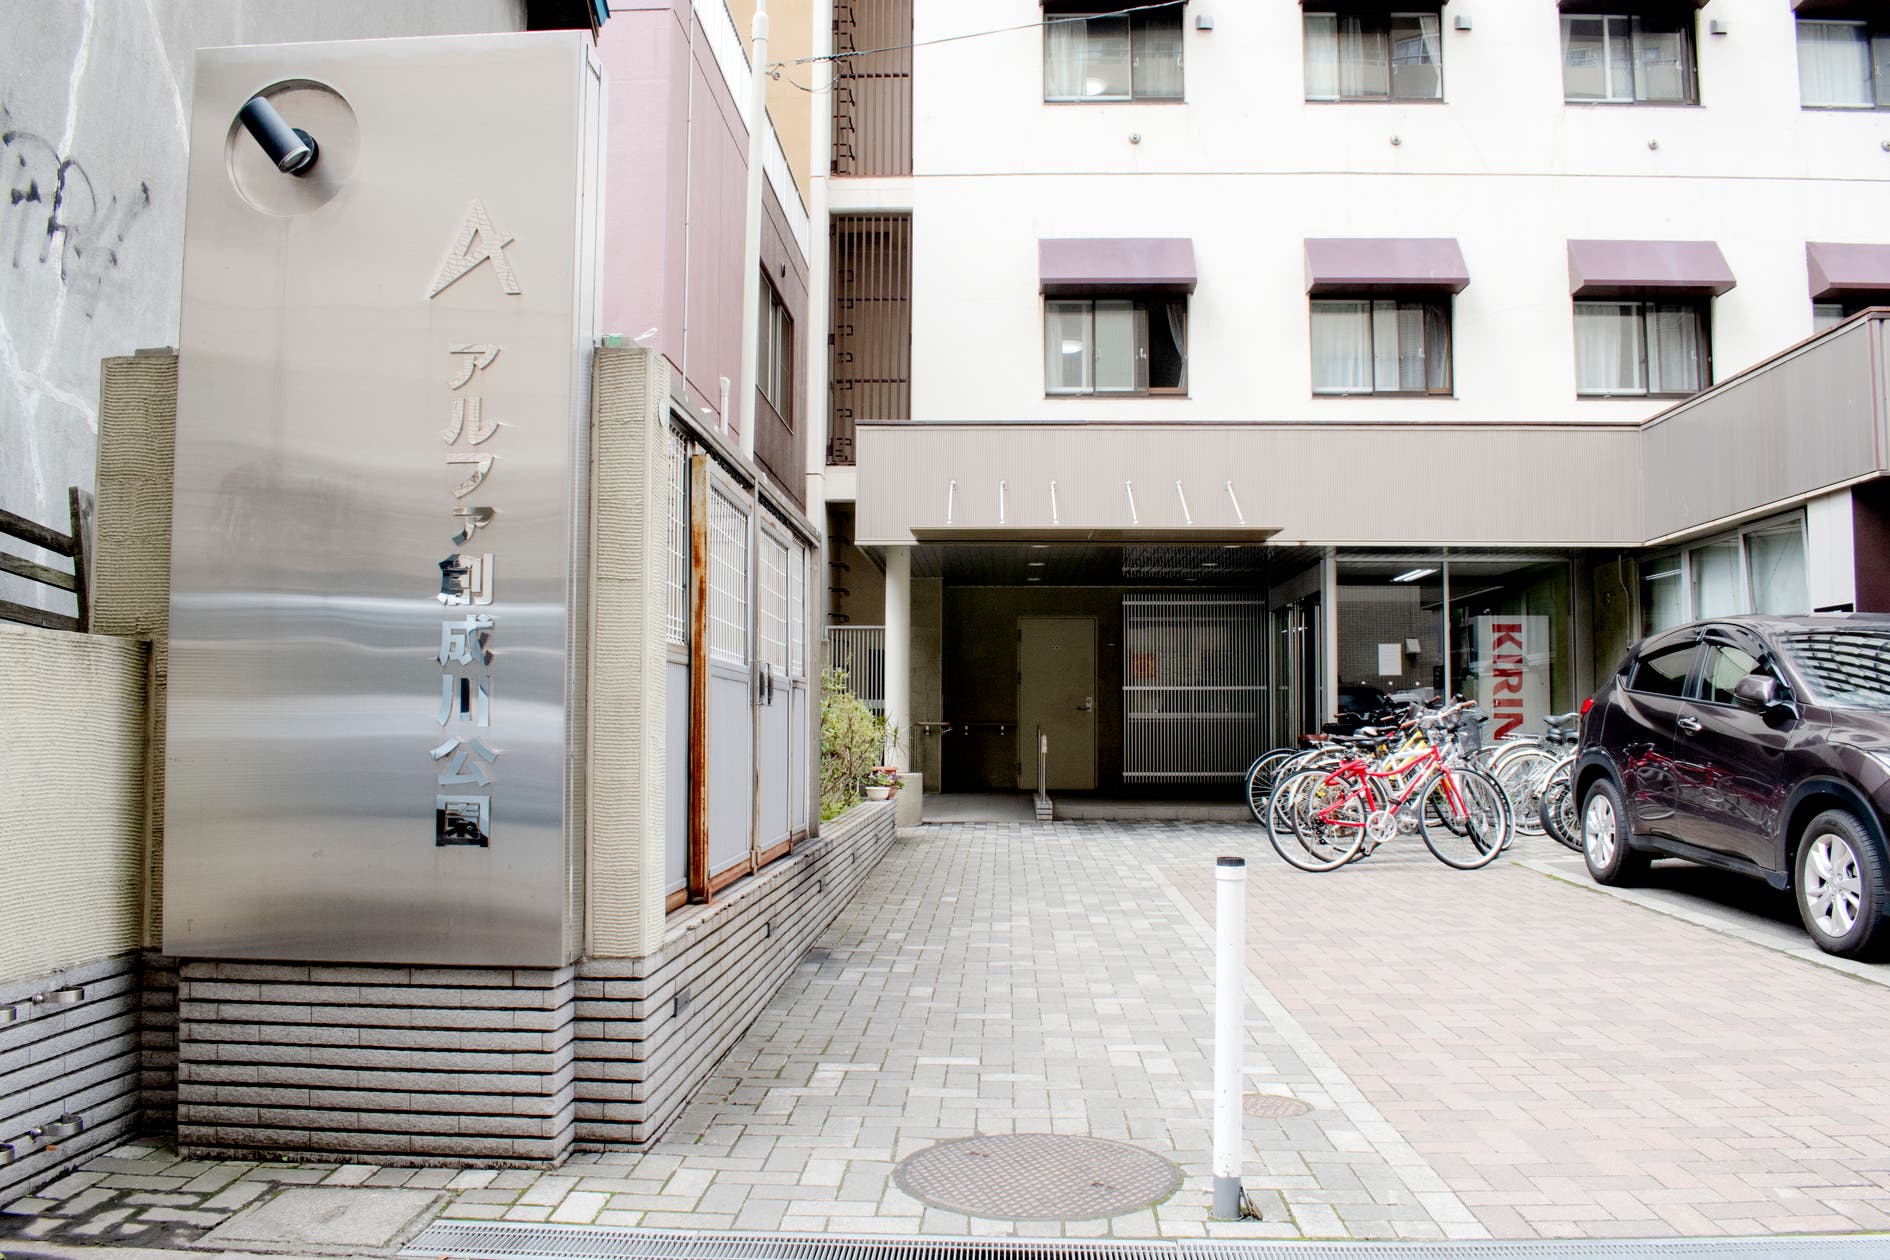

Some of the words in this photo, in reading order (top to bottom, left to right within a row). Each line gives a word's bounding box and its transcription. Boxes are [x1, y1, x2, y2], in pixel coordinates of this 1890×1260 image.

[430, 343, 499, 848] アルファ創成川公園
[1492, 623, 1524, 741] KIRIN
